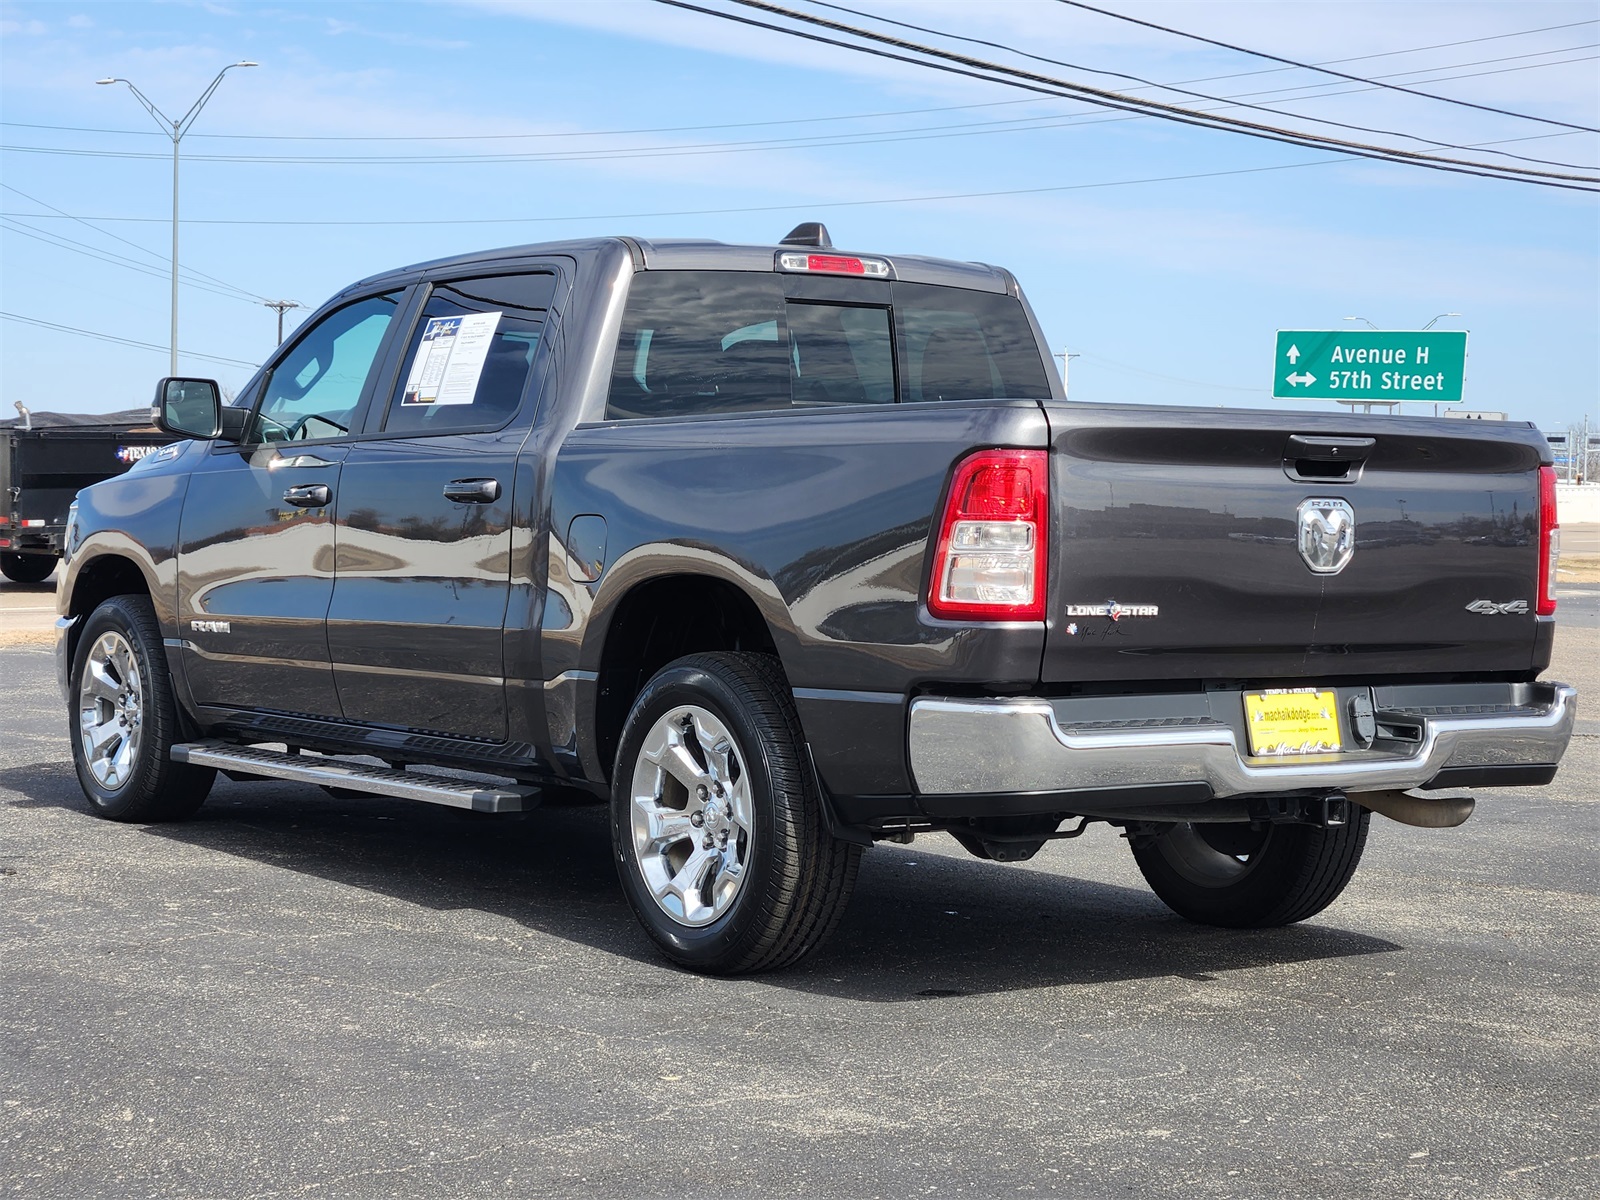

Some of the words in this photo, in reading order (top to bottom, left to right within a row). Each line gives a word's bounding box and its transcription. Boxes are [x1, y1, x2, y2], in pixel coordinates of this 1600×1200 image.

[1331, 345, 1406, 364] Avenue
[1416, 346, 1429, 364] H
[1329, 370, 1372, 389] 57th
[1381, 371, 1444, 390] Street
[1066, 605, 1106, 616] LONE
[1121, 605, 1159, 616] STAR
[191, 620, 230, 633] RAM
